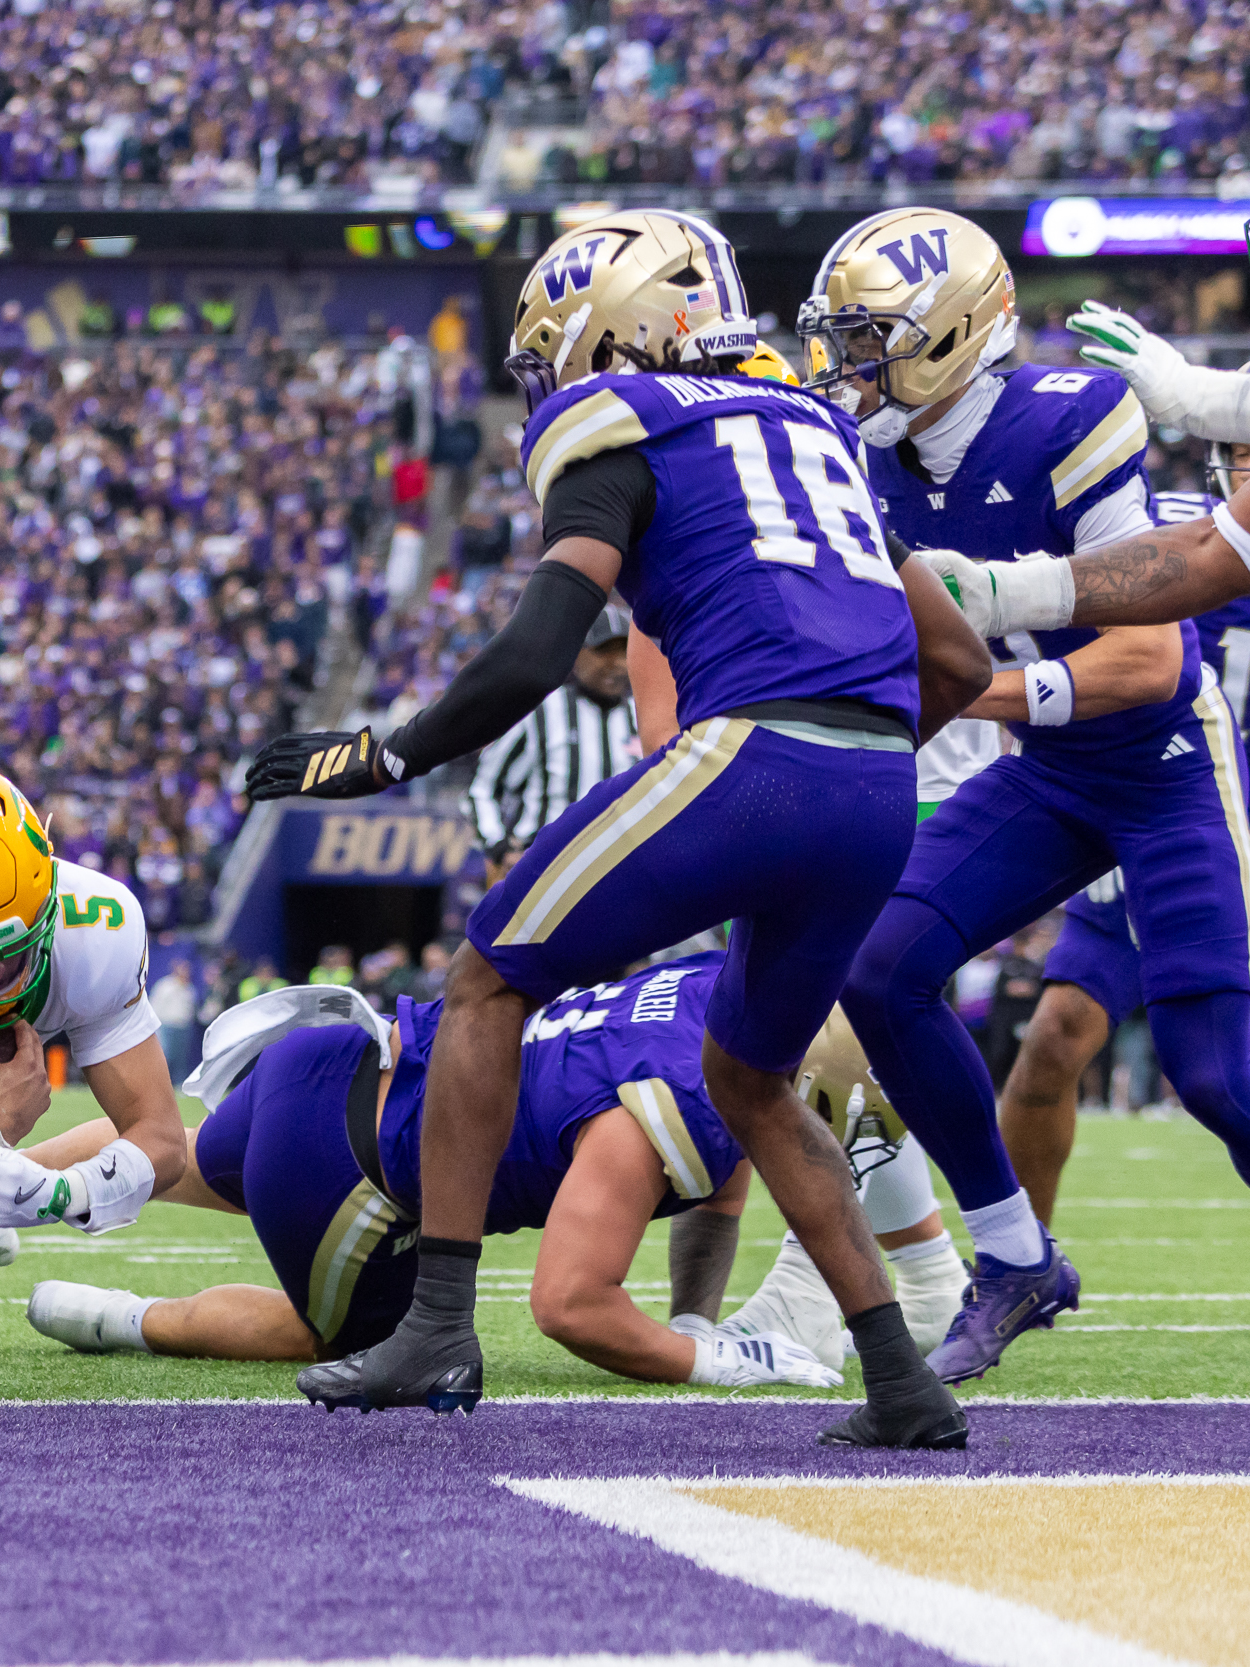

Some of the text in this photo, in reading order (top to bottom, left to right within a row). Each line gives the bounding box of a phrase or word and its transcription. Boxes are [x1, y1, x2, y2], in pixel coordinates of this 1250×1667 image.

[539, 232, 607, 307] W
[876, 228, 949, 287] W
[714, 414, 907, 597] 18
[927, 492, 946, 510] W
[308, 815, 476, 877] BOW
[58, 893, 125, 931] 5
